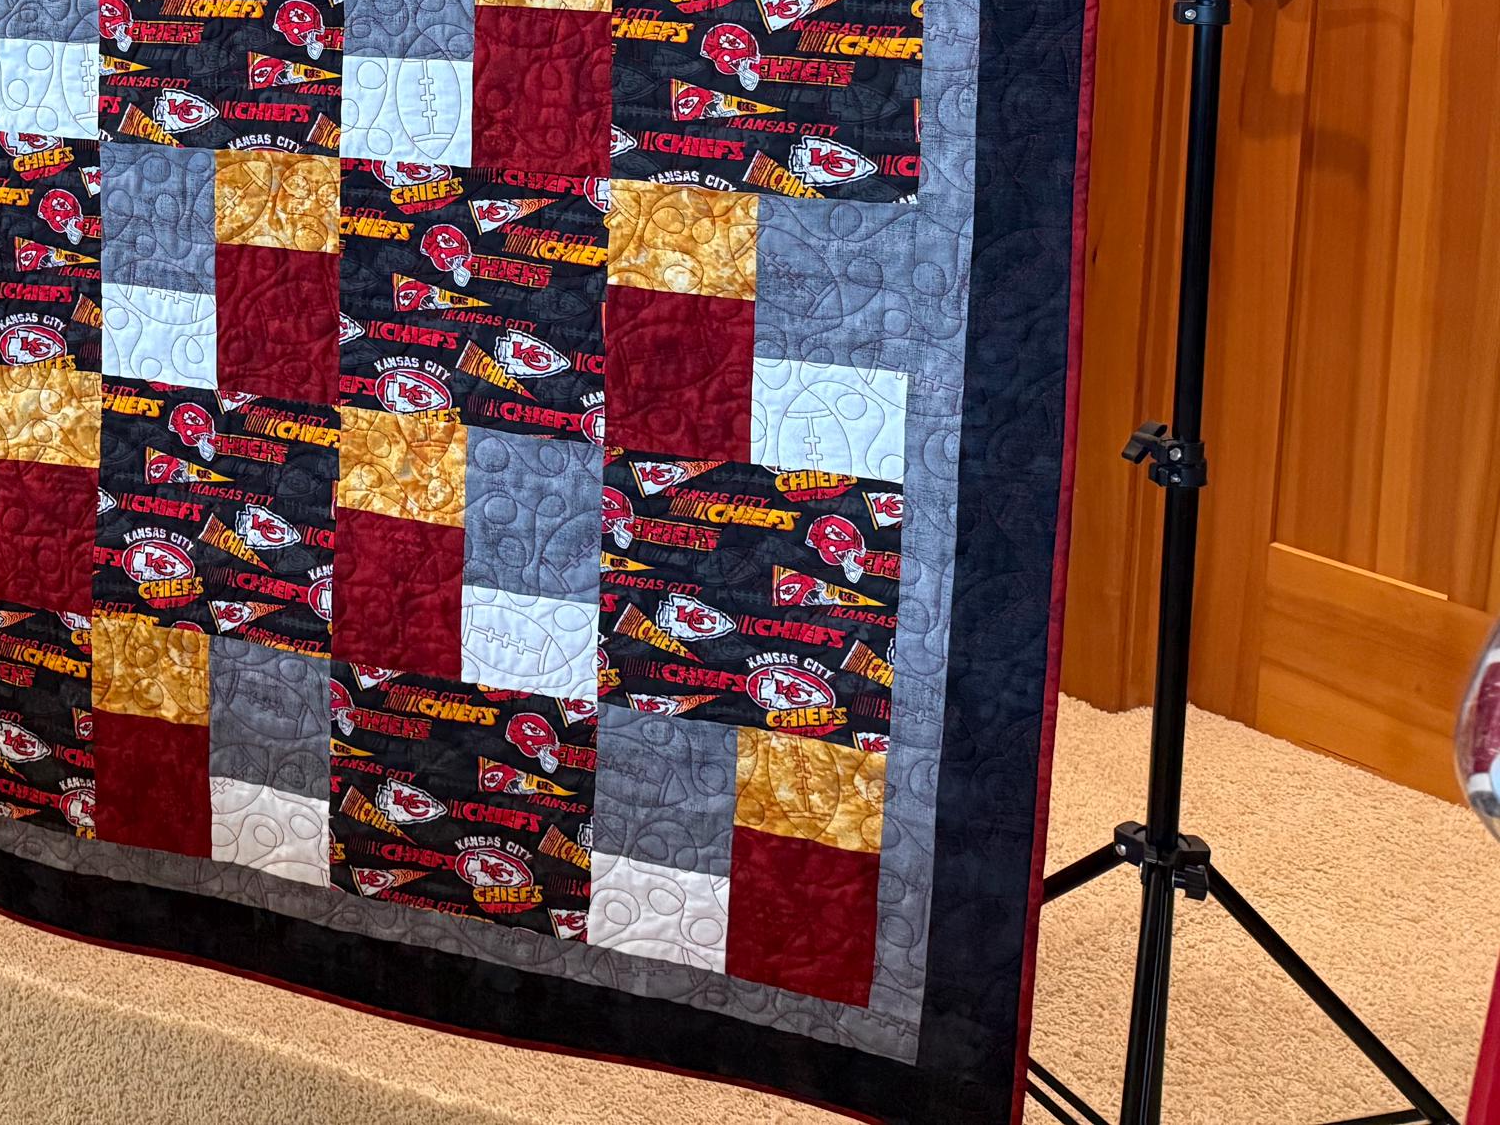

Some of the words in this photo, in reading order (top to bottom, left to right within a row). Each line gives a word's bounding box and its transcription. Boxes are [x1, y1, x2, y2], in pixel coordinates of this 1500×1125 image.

[193, 0, 267, 18] CHIEFS
[795, 21, 862, 36] KANSAS
[866, 25, 906, 39] CITY
[109, 75, 159, 87] KANSAS
[162, 78, 191, 89] CITY
[235, 102, 311, 122] CHIEFS
[731, 118, 796, 134] KANSAS
[800, 123, 840, 137] CITY
[654, 132, 746, 161] CHIEFS
[13, 147, 74, 173] CHIEFS
[391, 176, 463, 205] CHIEFS
[500, 224, 560, 240] KANSAS
[563, 232, 598, 246] CITY
[3, 283, 74, 303] CHIEFS
[43, 314, 66, 331] CITY
[443, 310, 503, 326] KANSAS
[506, 318, 537, 332] CITY
[381, 322, 461, 349] CHIEFS
[374, 356, 420, 373] KANSAS
[425, 361, 450, 381] CITY
[239, 404, 295, 421] KANSAS
[298, 414, 328, 426] CITY
[190, 484, 242, 500] KANSAS
[244, 493, 274, 506] CITY
[663, 486, 729, 505] KANSAS
[733, 495, 770, 509] CITY
[131, 494, 204, 522] CHIEFS
[706, 502, 801, 531] CHIEFS
[124, 528, 166, 544] KANSAS
[171, 532, 195, 551] CITY
[139, 577, 204, 598] CHIEFS
[603, 572, 663, 590] KANSAS
[667, 582, 703, 595] CITY
[752, 618, 848, 649] CHIEFS
[748, 651, 798, 669] KANSAS
[804, 658, 834, 680] CITY
[418, 699, 500, 725] CHIEFS
[766, 707, 848, 728] CHIEFS
[463, 803, 542, 832] CHIEFS
[455, 837, 500, 850] KANSAS
[506, 841, 533, 861] CITY
[473, 885, 543, 903] CHIEFS
